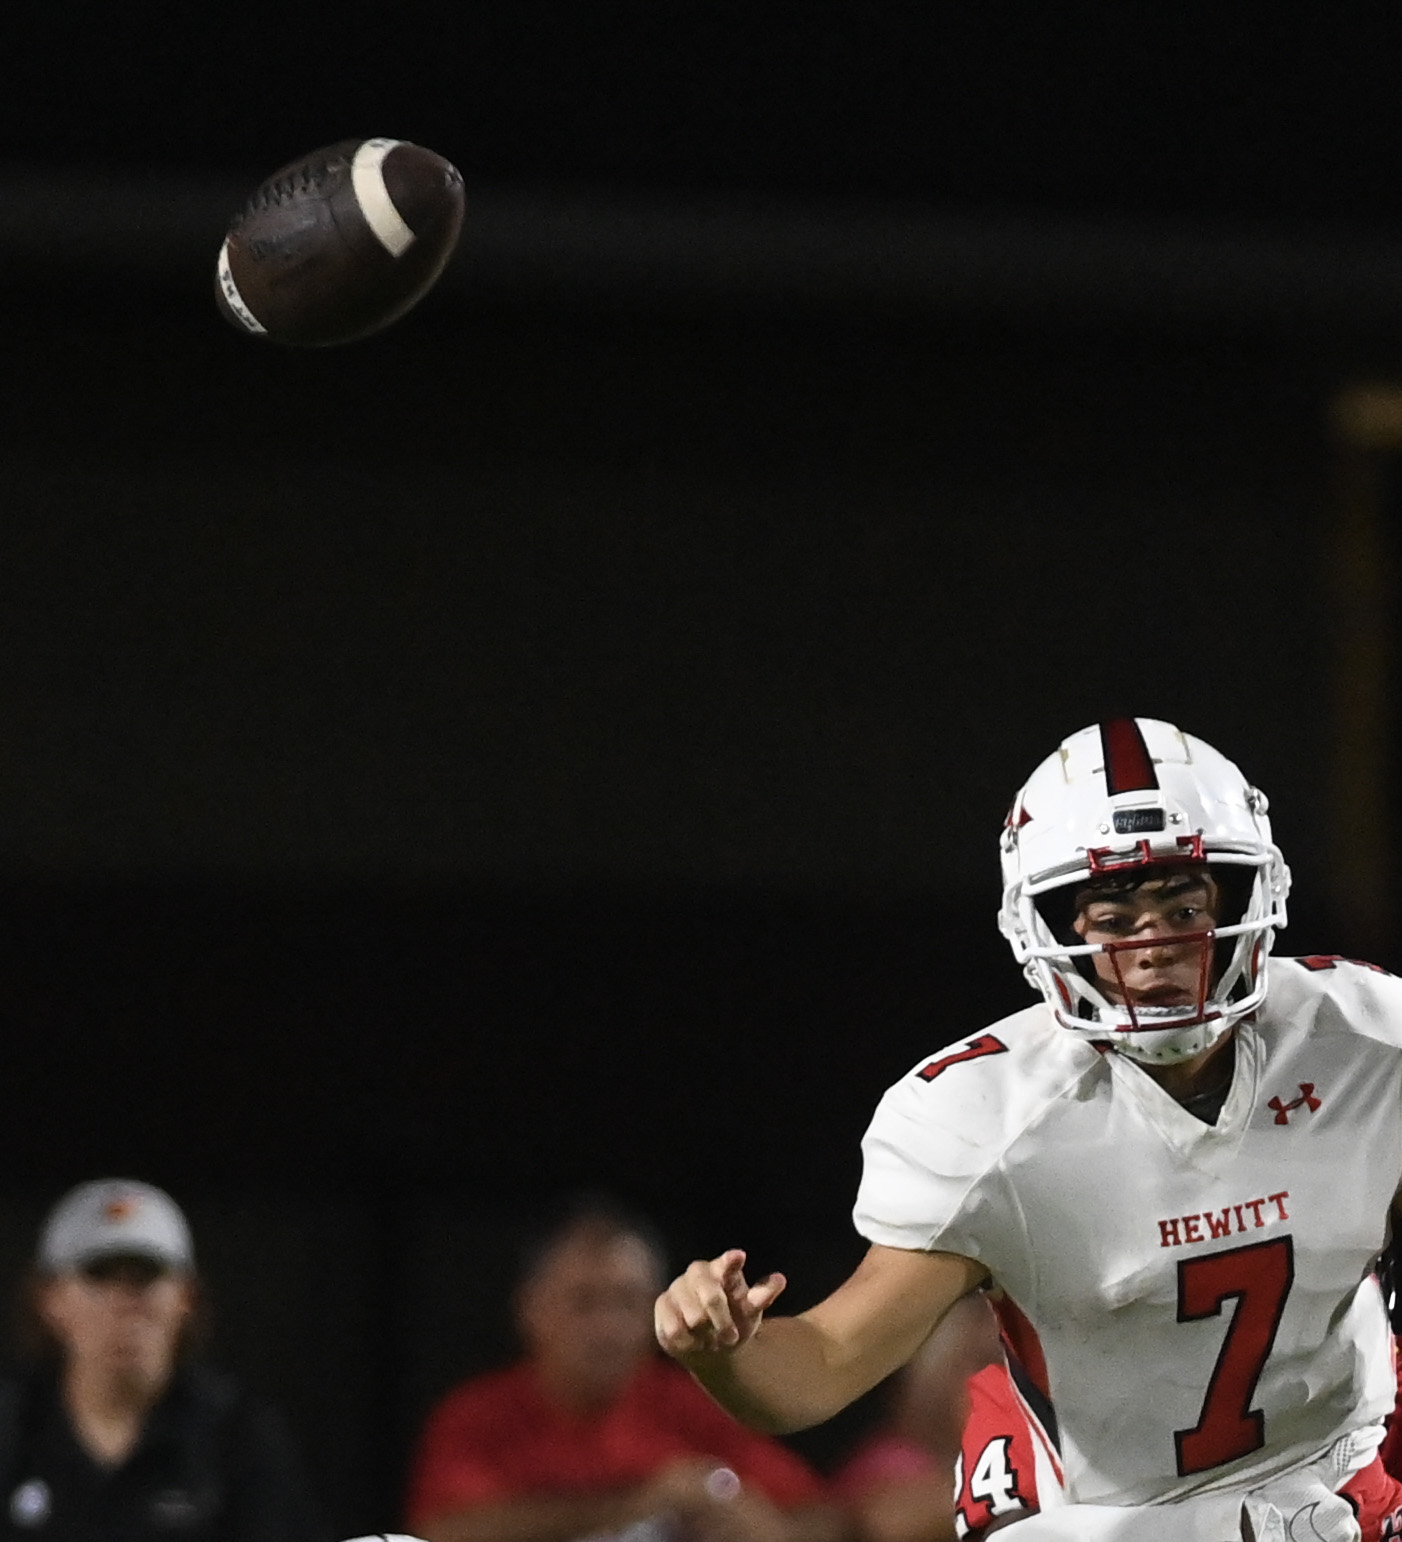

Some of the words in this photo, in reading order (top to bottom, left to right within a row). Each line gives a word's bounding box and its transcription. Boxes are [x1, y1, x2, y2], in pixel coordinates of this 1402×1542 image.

[914, 1032, 1010, 1083] 7
[1158, 1190, 1289, 1247] HEWITT
[1174, 1234, 1295, 1480] 7
